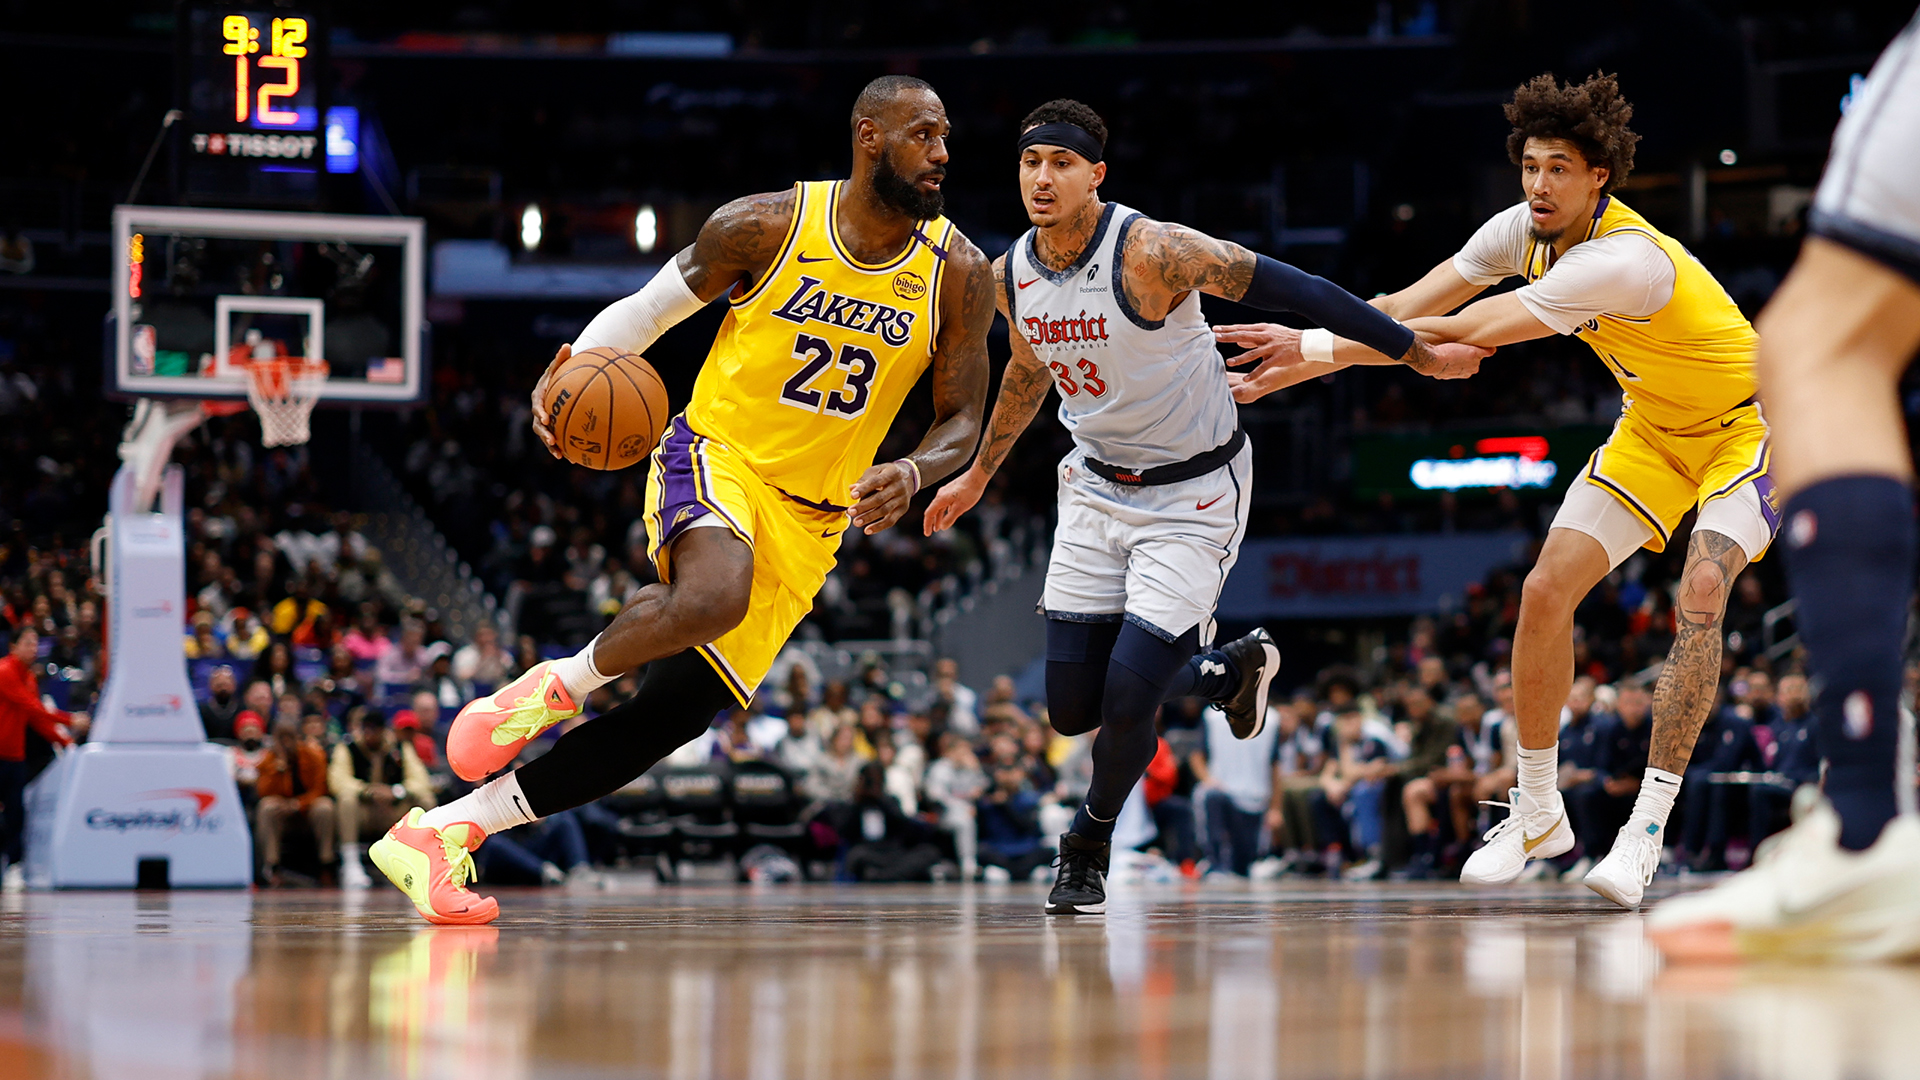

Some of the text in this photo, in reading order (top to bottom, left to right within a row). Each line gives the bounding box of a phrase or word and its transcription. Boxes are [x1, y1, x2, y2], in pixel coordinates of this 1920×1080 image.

[222, 15, 308, 58] 9:12
[235, 55, 299, 125] 12
[226, 133, 318, 159] TISSOT
[896, 277, 924, 294] bibigo
[1079, 286, 1108, 294] Robinhood
[770, 274, 917, 348] LAKERS
[1022, 309, 1109, 345] District
[1050, 343, 1109, 352] COLUMBIA
[778, 331, 879, 421] 23
[1049, 357, 1109, 399] 33
